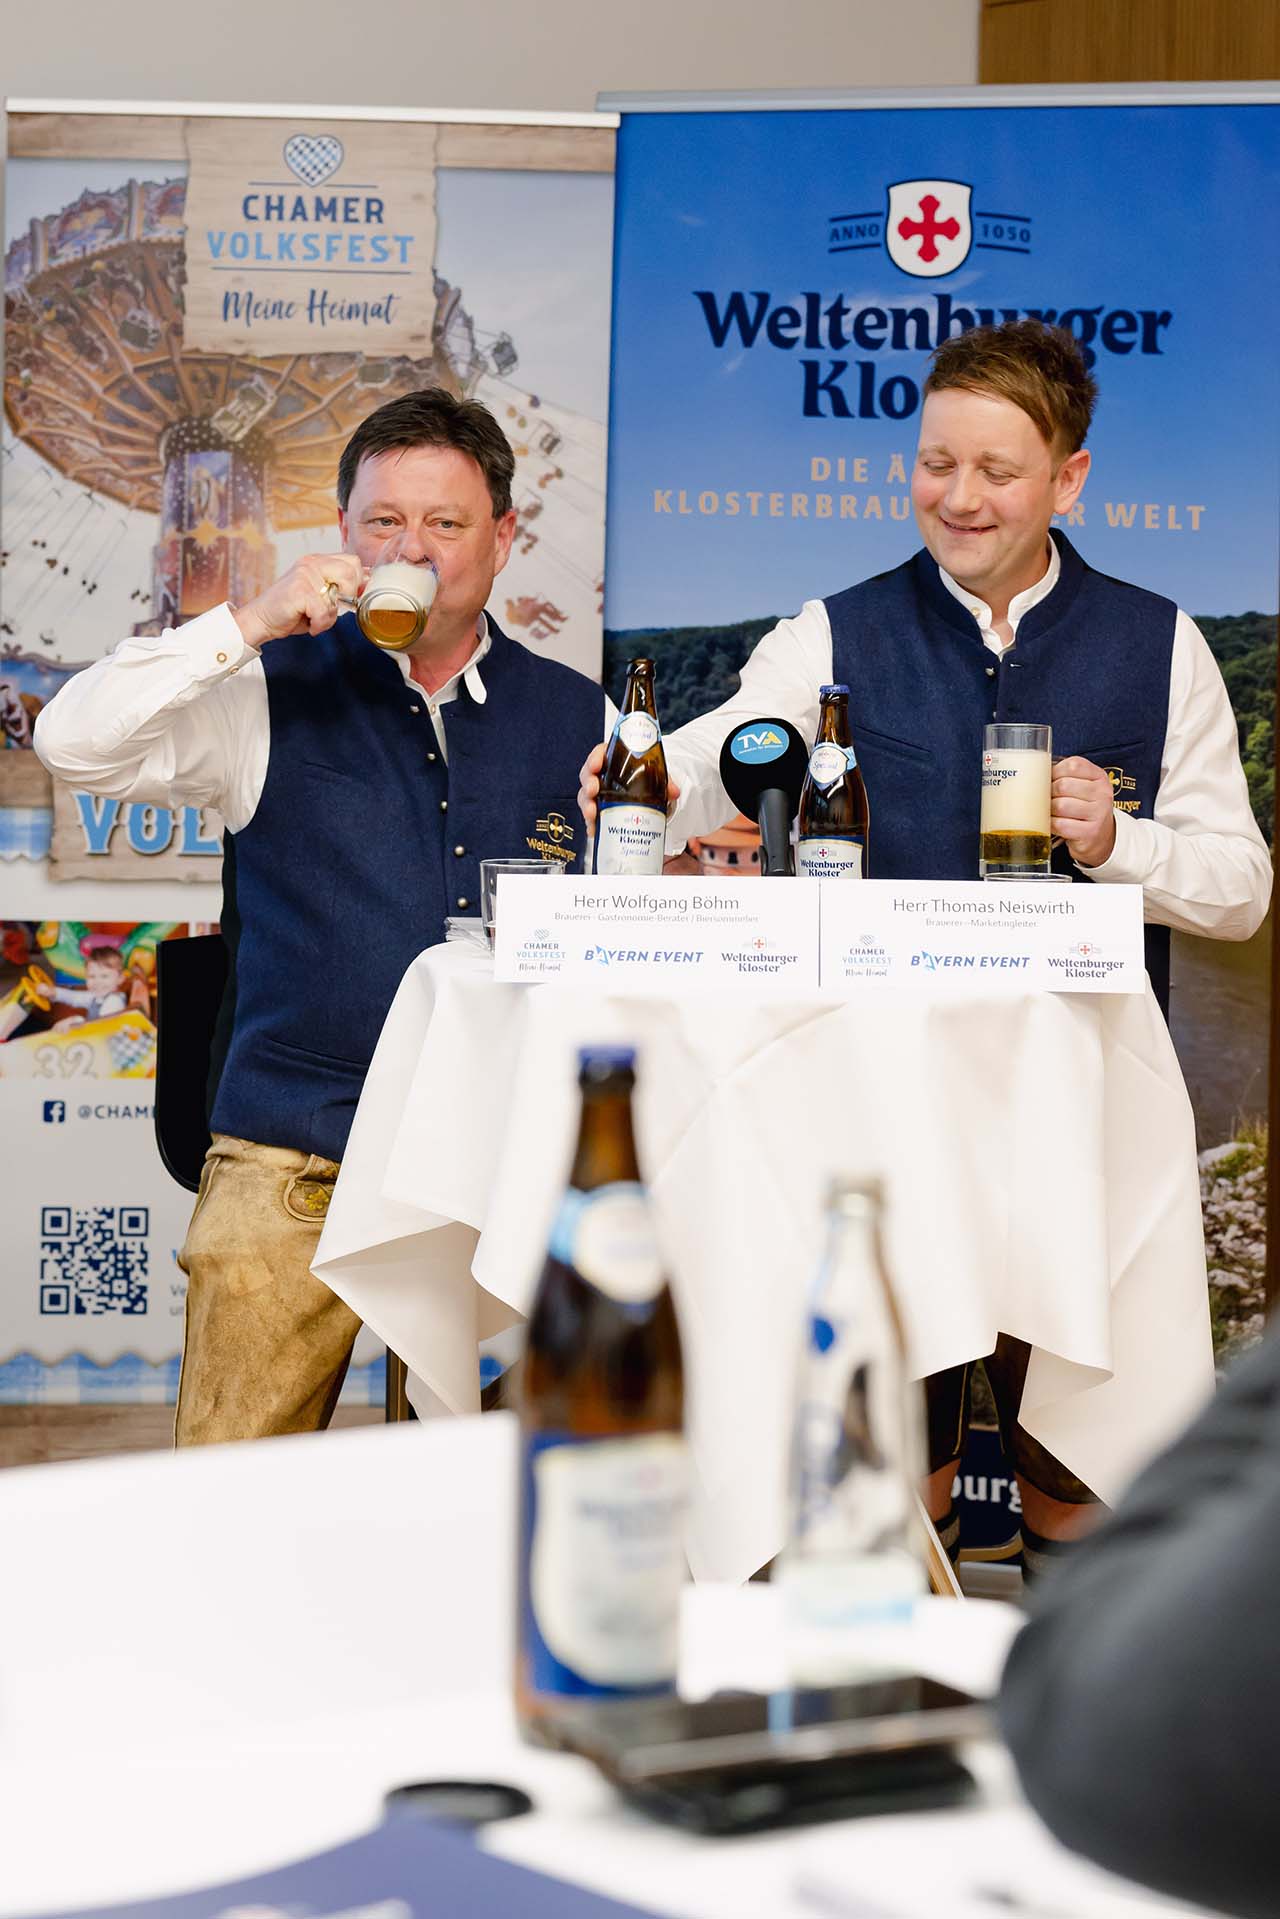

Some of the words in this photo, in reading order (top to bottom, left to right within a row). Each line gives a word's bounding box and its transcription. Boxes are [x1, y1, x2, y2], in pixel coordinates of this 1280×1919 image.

[241, 194, 384, 224] CHAMER
[829, 222, 881, 242] ANNO
[981, 223, 1031, 243] 1050
[206, 231, 415, 264] VOLKSFEST
[222, 290, 297, 327] Meine
[306, 288, 401, 327] Heimat
[810, 457, 869, 482] DIE
[653, 489, 911, 521] KLOSTERBRAU
[1104, 502, 1207, 531] WELT
[737, 730, 783, 749] TVA
[608, 826, 661, 840] Weltenburger
[619, 836, 651, 846] Kloster
[800, 859, 854, 871] Weltenburger
[808, 869, 840, 877] Kloster
[573, 895, 608, 909] Herr
[612, 894, 688, 914] Wolfgang
[692, 895, 740, 910] Böhm
[893, 898, 929, 912] Herr
[931, 899, 995, 914] Thomas
[999, 900, 1076, 915] Neiswirth
[523, 942, 559, 950] CHAMER
[849, 948, 885, 956] CHAMER
[653, 951, 704, 962] EVENT
[721, 953, 798, 965] Weltenburger
[980, 956, 1031, 968] EVENT
[738, 962, 780, 973] Kloster
[1047, 958, 1124, 971] Weltenburger
[1065, 968, 1107, 978] Kloster
